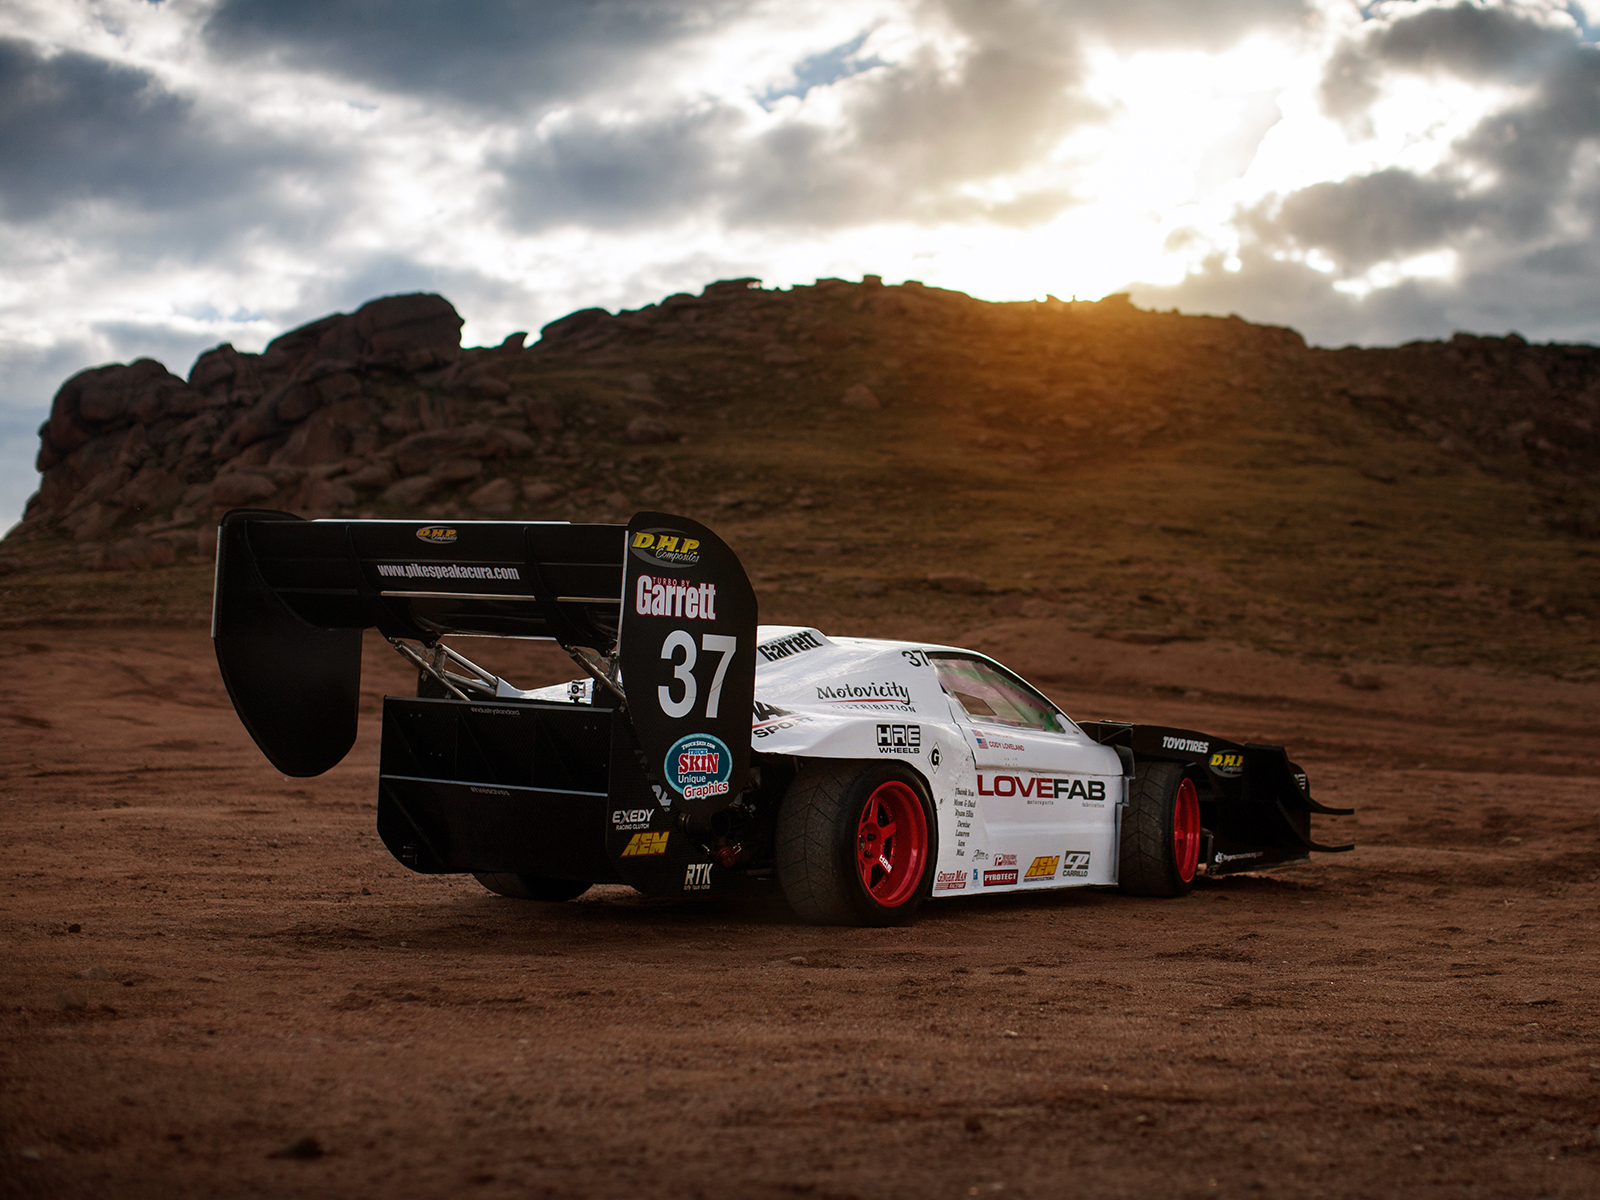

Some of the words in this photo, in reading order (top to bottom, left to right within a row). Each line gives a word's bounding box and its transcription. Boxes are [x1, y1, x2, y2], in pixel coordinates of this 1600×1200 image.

[376, 563, 520, 580] www.pikespeakacura.com
[652, 576, 677, 585] TURBO
[680, 578, 690, 586] BY
[635, 574, 716, 620] Garrett
[757, 630, 823, 662] Garrett
[902, 649, 930, 666] 37
[657, 629, 736, 718] 37
[816, 681, 910, 705] Motovicity
[876, 724, 920, 746] HRE
[988, 740, 1001, 748] CODY
[1002, 742, 1025, 751] LOVELAND
[678, 752, 718, 773] SKIN
[678, 774, 706, 783] Unique
[976, 774, 1105, 800] LOVEFAB
[683, 780, 729, 799] Graphics
[611, 808, 654, 823] EXEDY
[684, 863, 713, 884] RTK
[984, 872, 1017, 881] PYROTECT
